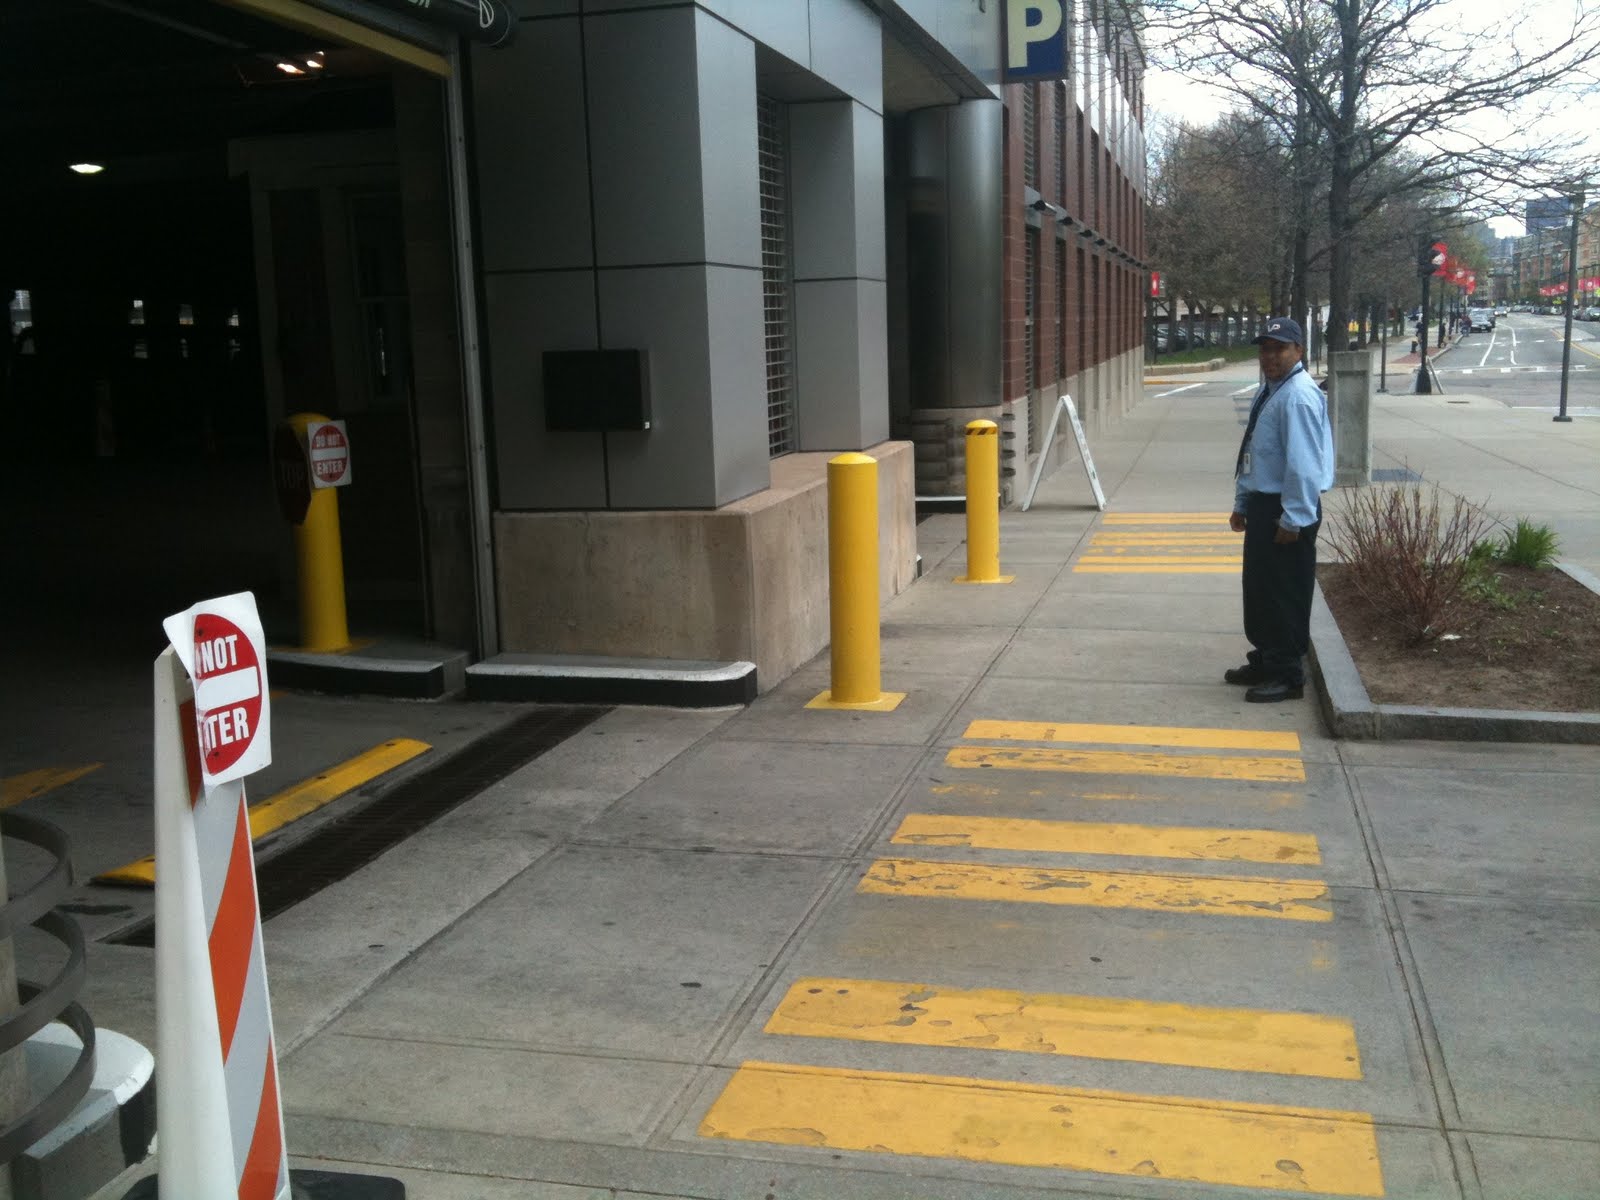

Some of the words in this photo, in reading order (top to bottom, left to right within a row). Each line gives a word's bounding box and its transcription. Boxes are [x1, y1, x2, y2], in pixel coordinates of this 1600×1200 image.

[1007, 0, 1062, 68] P
[315, 435, 326, 448] DO
[327, 434, 341, 447] NOT
[317, 461, 343, 476] ENTER
[201, 634, 238, 673] NOT
